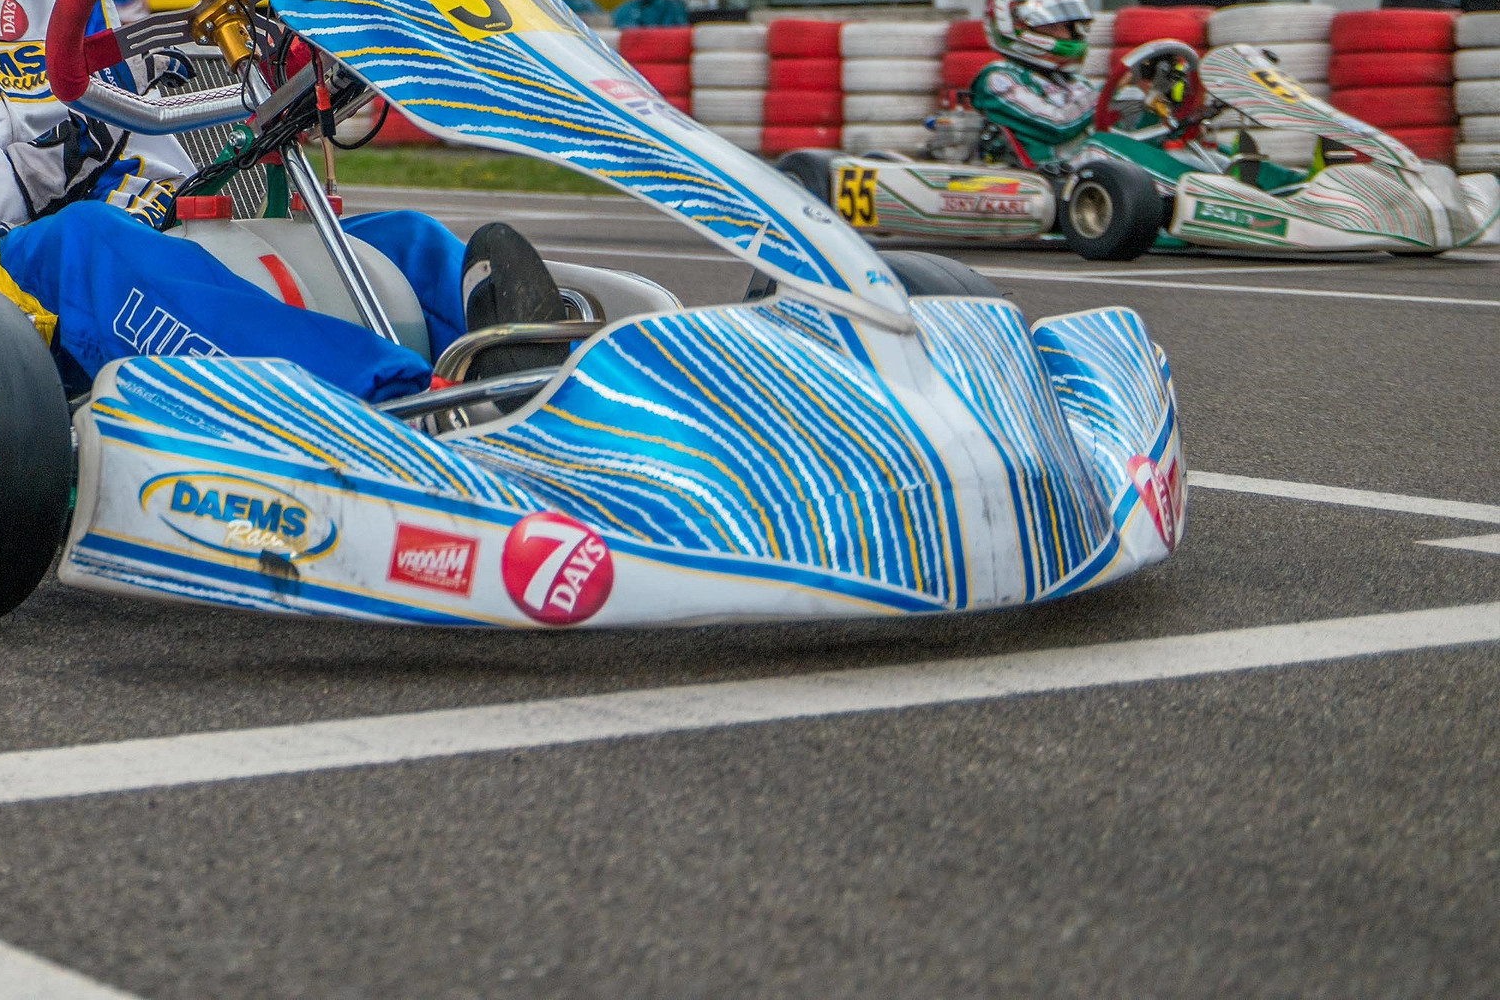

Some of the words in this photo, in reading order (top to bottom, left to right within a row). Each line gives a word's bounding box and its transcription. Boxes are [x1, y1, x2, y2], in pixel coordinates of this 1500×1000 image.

[2, 1, 17, 34] DAYS
[840, 169, 875, 223] 55
[170, 479, 307, 538] DAEMS
[522, 520, 589, 612] 7
[549, 536, 607, 614] DAYS
